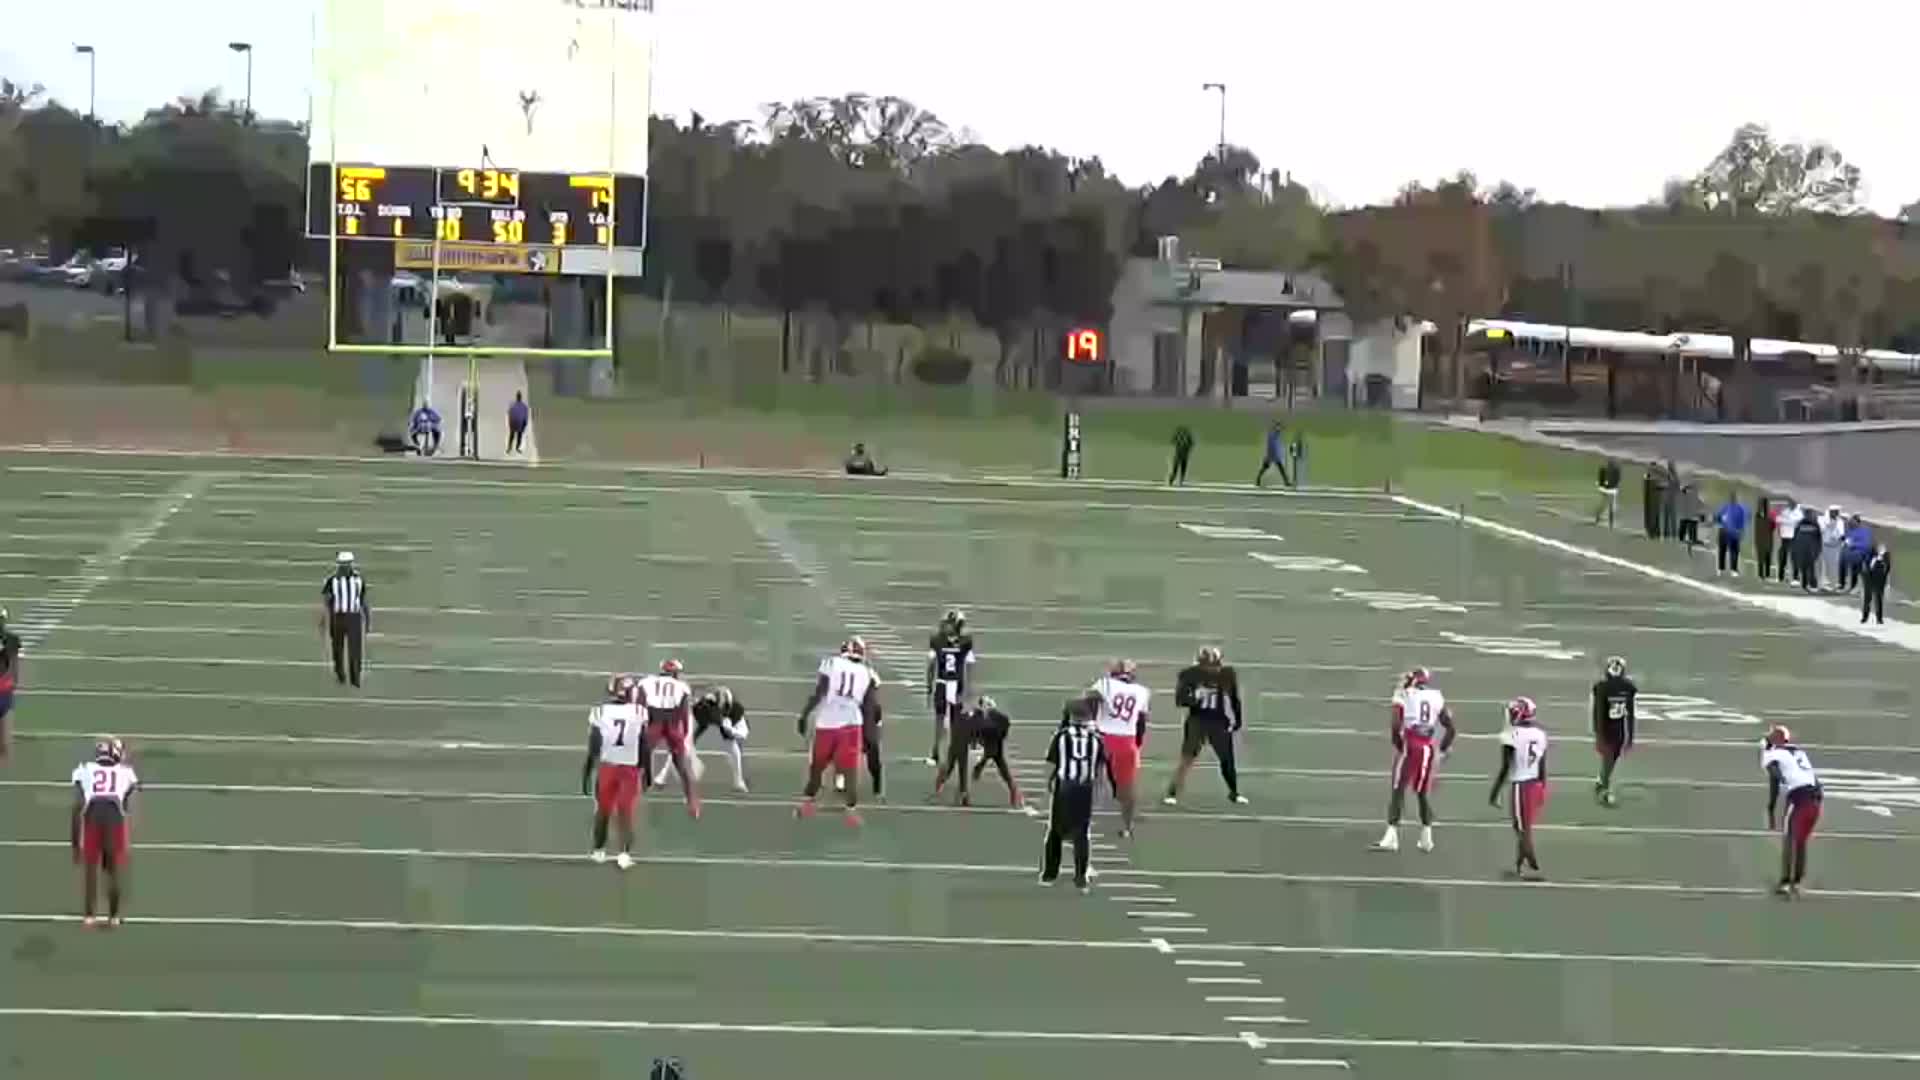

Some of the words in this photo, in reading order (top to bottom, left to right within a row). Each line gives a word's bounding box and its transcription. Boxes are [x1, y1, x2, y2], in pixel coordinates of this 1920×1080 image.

[1068, 330, 1097, 360] 19
[945, 654, 956, 672] 2
[655, 681, 675, 697] 10
[1111, 692, 1136, 721] 99
[614, 719, 626, 747] 7
[93, 770, 117, 793] 21
